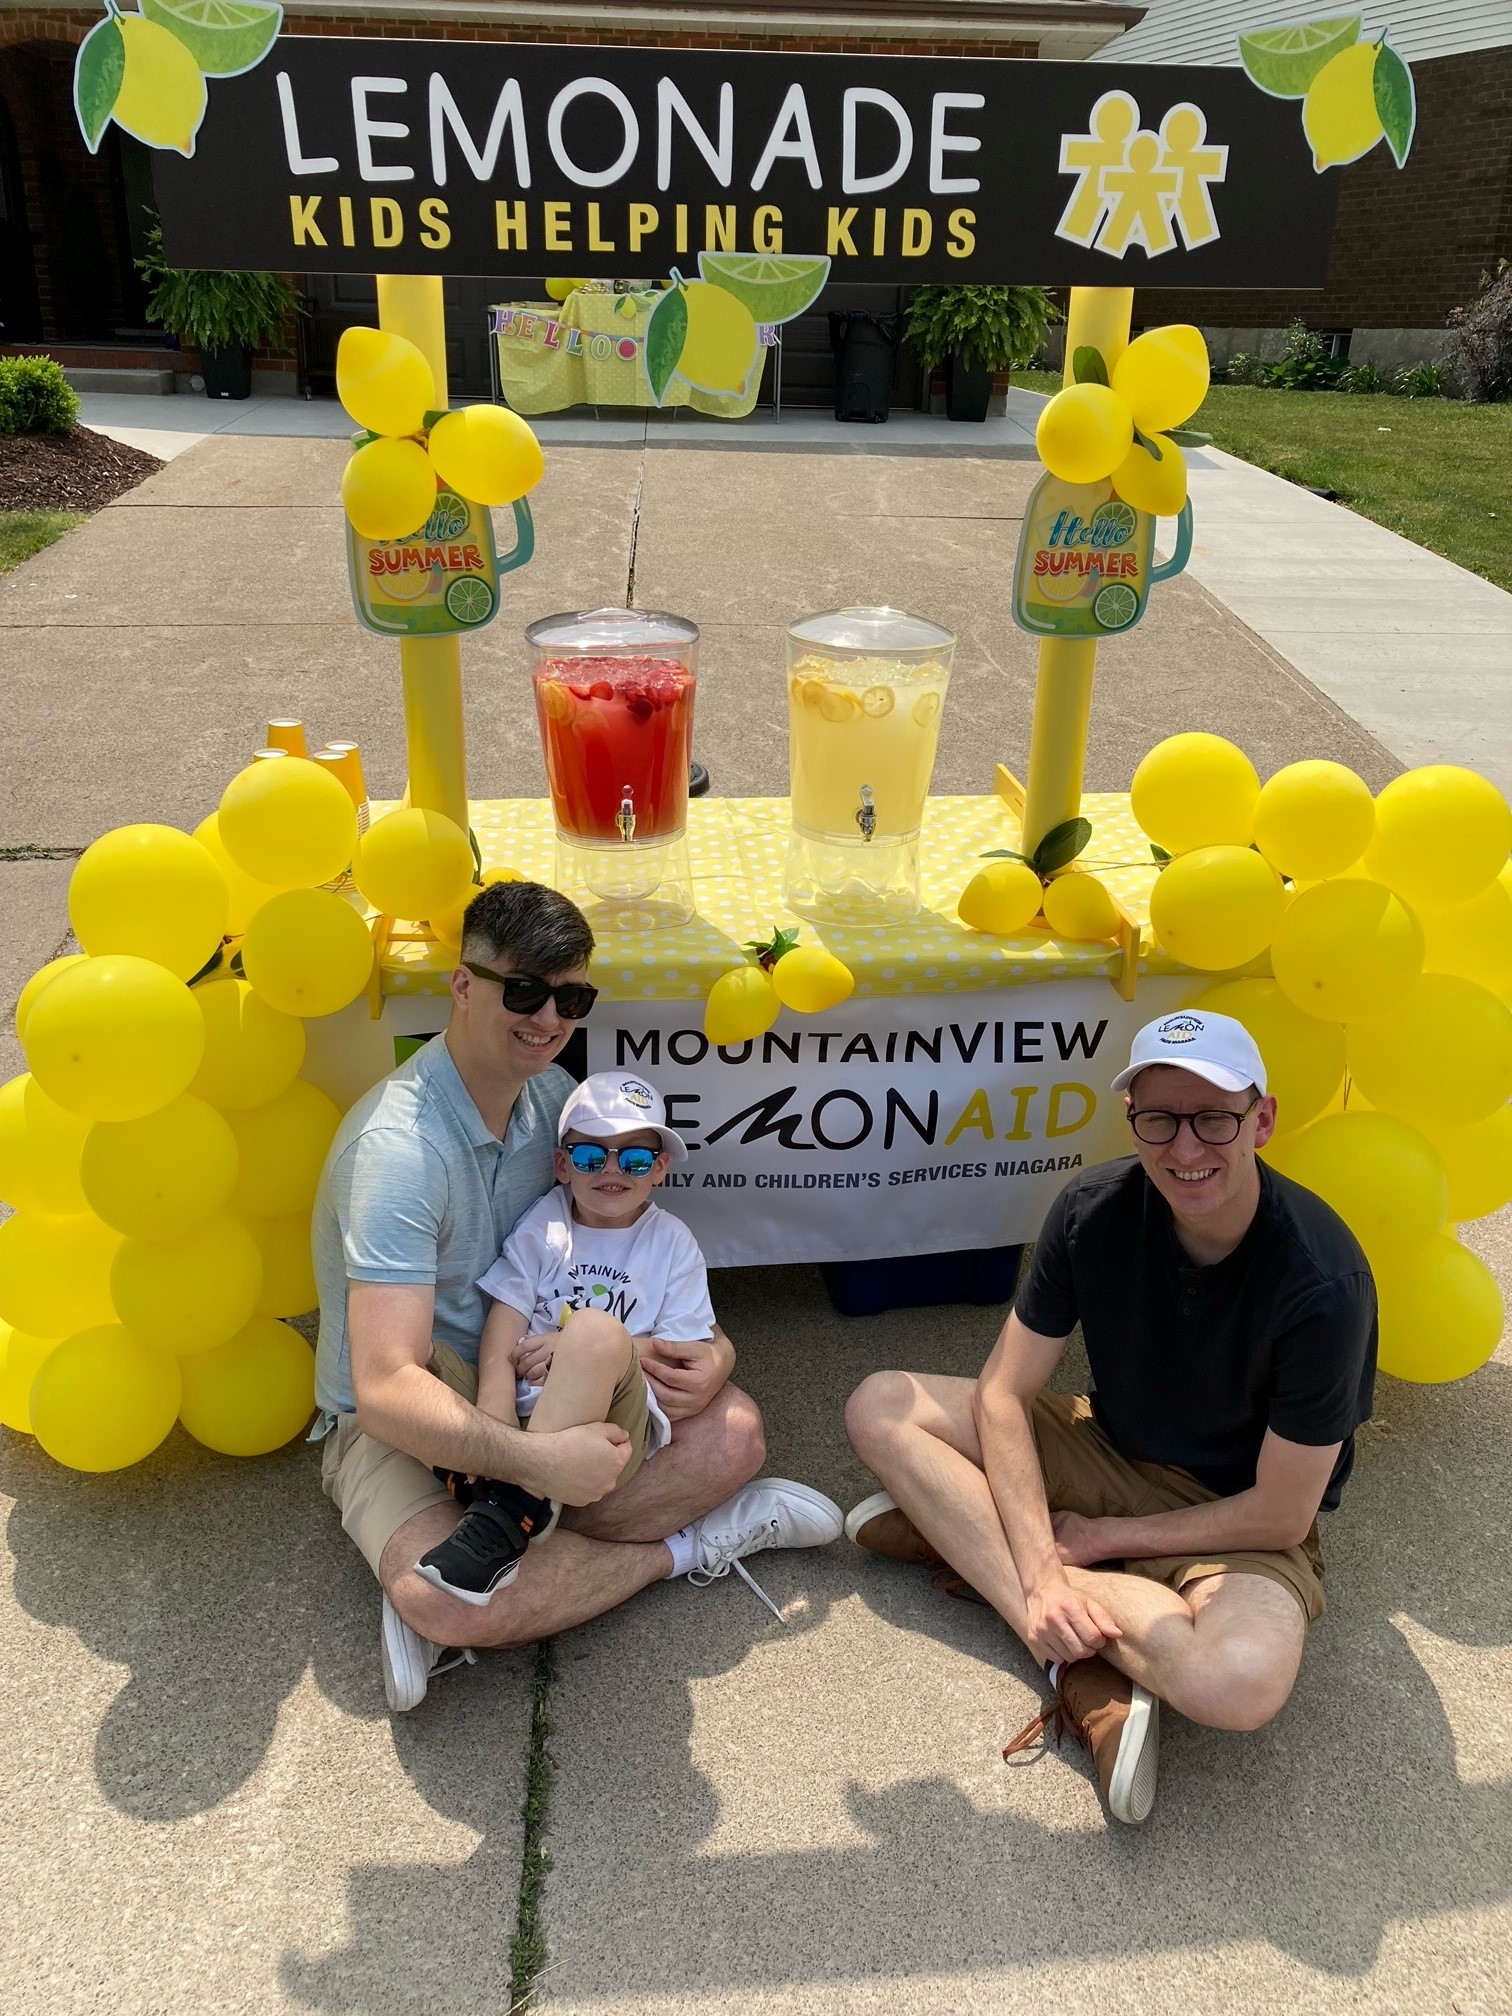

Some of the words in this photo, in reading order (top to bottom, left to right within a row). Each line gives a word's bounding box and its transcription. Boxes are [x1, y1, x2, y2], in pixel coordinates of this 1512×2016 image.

[276, 71, 986, 195] LEMONADE
[289, 195, 452, 250] KIDS
[496, 200, 783, 255] HELPING
[827, 207, 977, 258] KIDS
[494, 308, 613, 361] HELLO
[379, 510, 464, 545] llo
[1048, 509, 1131, 548] Hello
[368, 544, 485, 574] SUMMER
[1033, 550, 1139, 578] SUMMER
[616, 1019, 1109, 1066] MOUNTAINVIEW
[664, 1082, 1097, 1151] EMONAID
[652, 1173, 695, 1188] ILY
[702, 1173, 747, 1188] AND
[755, 1172, 880, 1189] CHILDREN’S
[888, 1162, 987, 1186] SERVICES
[994, 1153, 1083, 1177] NIAGARA
